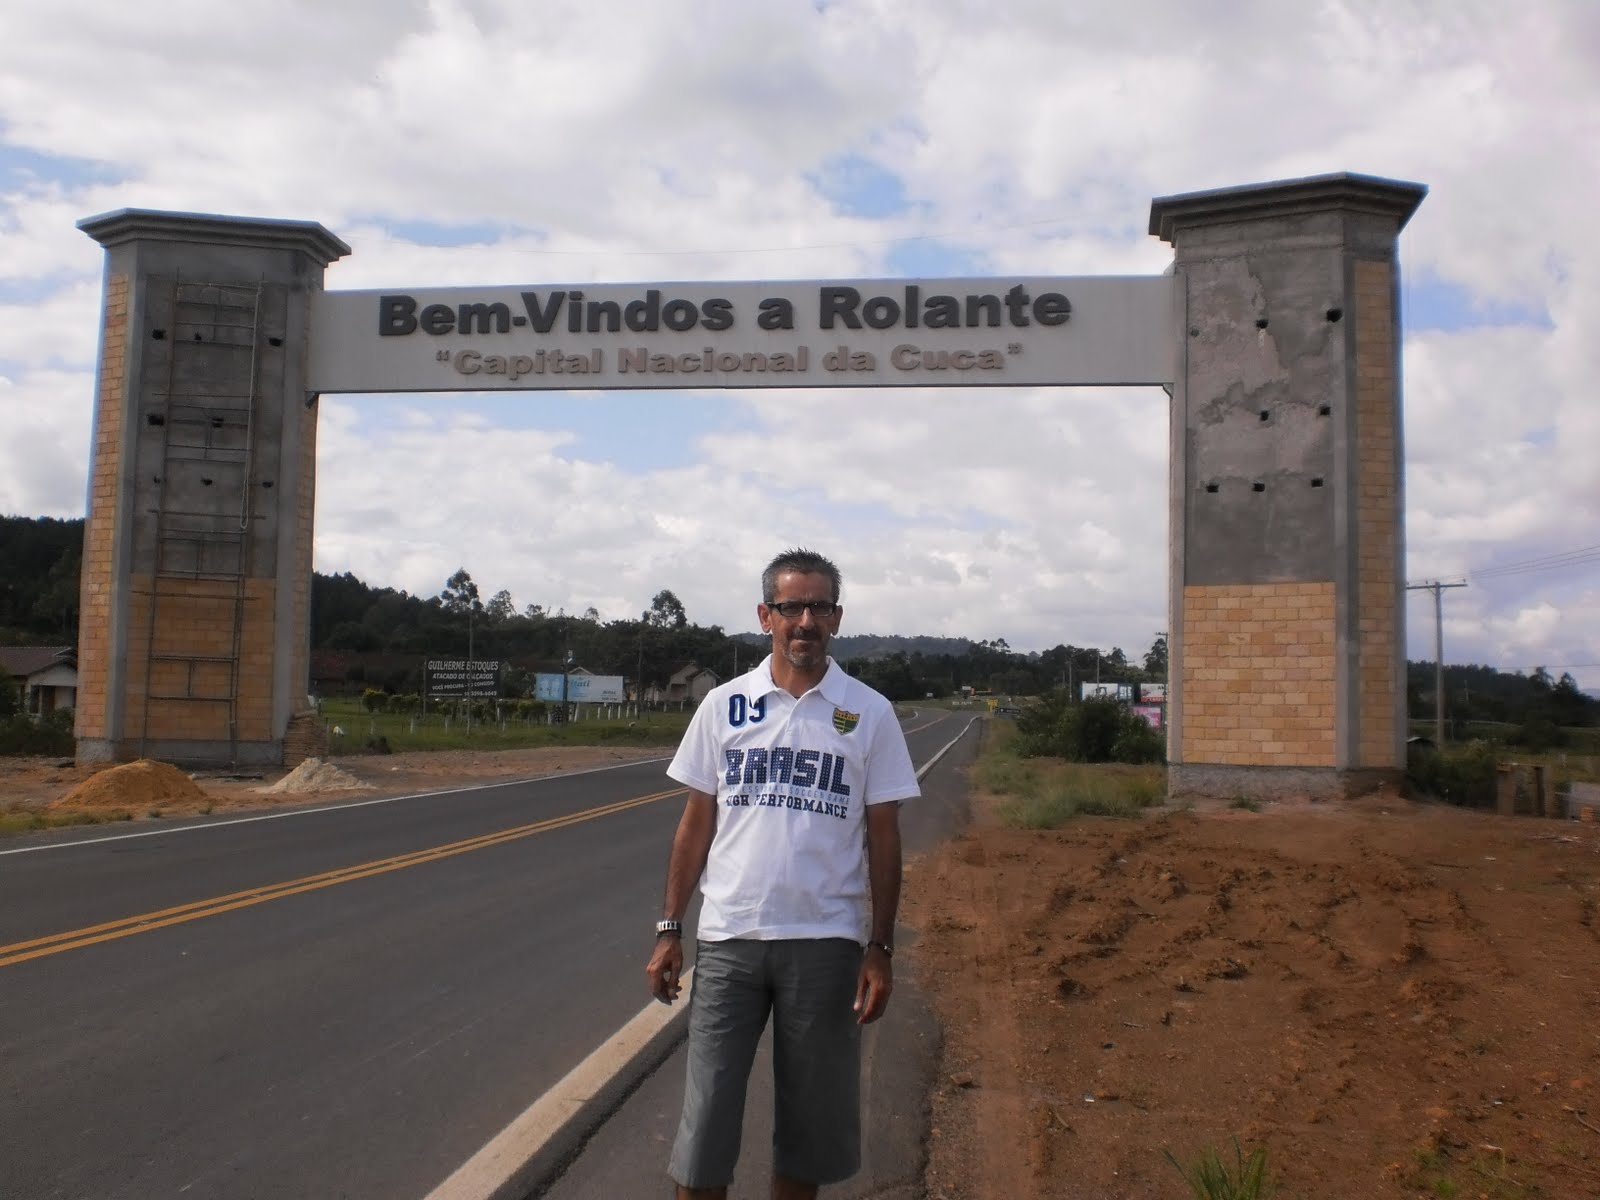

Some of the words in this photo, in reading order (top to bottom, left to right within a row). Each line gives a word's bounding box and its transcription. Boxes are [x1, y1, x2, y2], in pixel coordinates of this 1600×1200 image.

[379, 290, 734, 336] Bem-Vindos
[757, 297, 794, 330] a
[819, 284, 1072, 330] Rolante
[617, 346, 808, 374] Nacional
[822, 346, 876, 372] da
[427, 660, 466, 671] GUILHERME
[466, 673, 494, 681] CLÇADOS
[729, 694, 766, 728] 09
[725, 747, 850, 796] BRASIL
[789, 786, 825, 799] SOCCER
[827, 793, 850, 805] GAME
